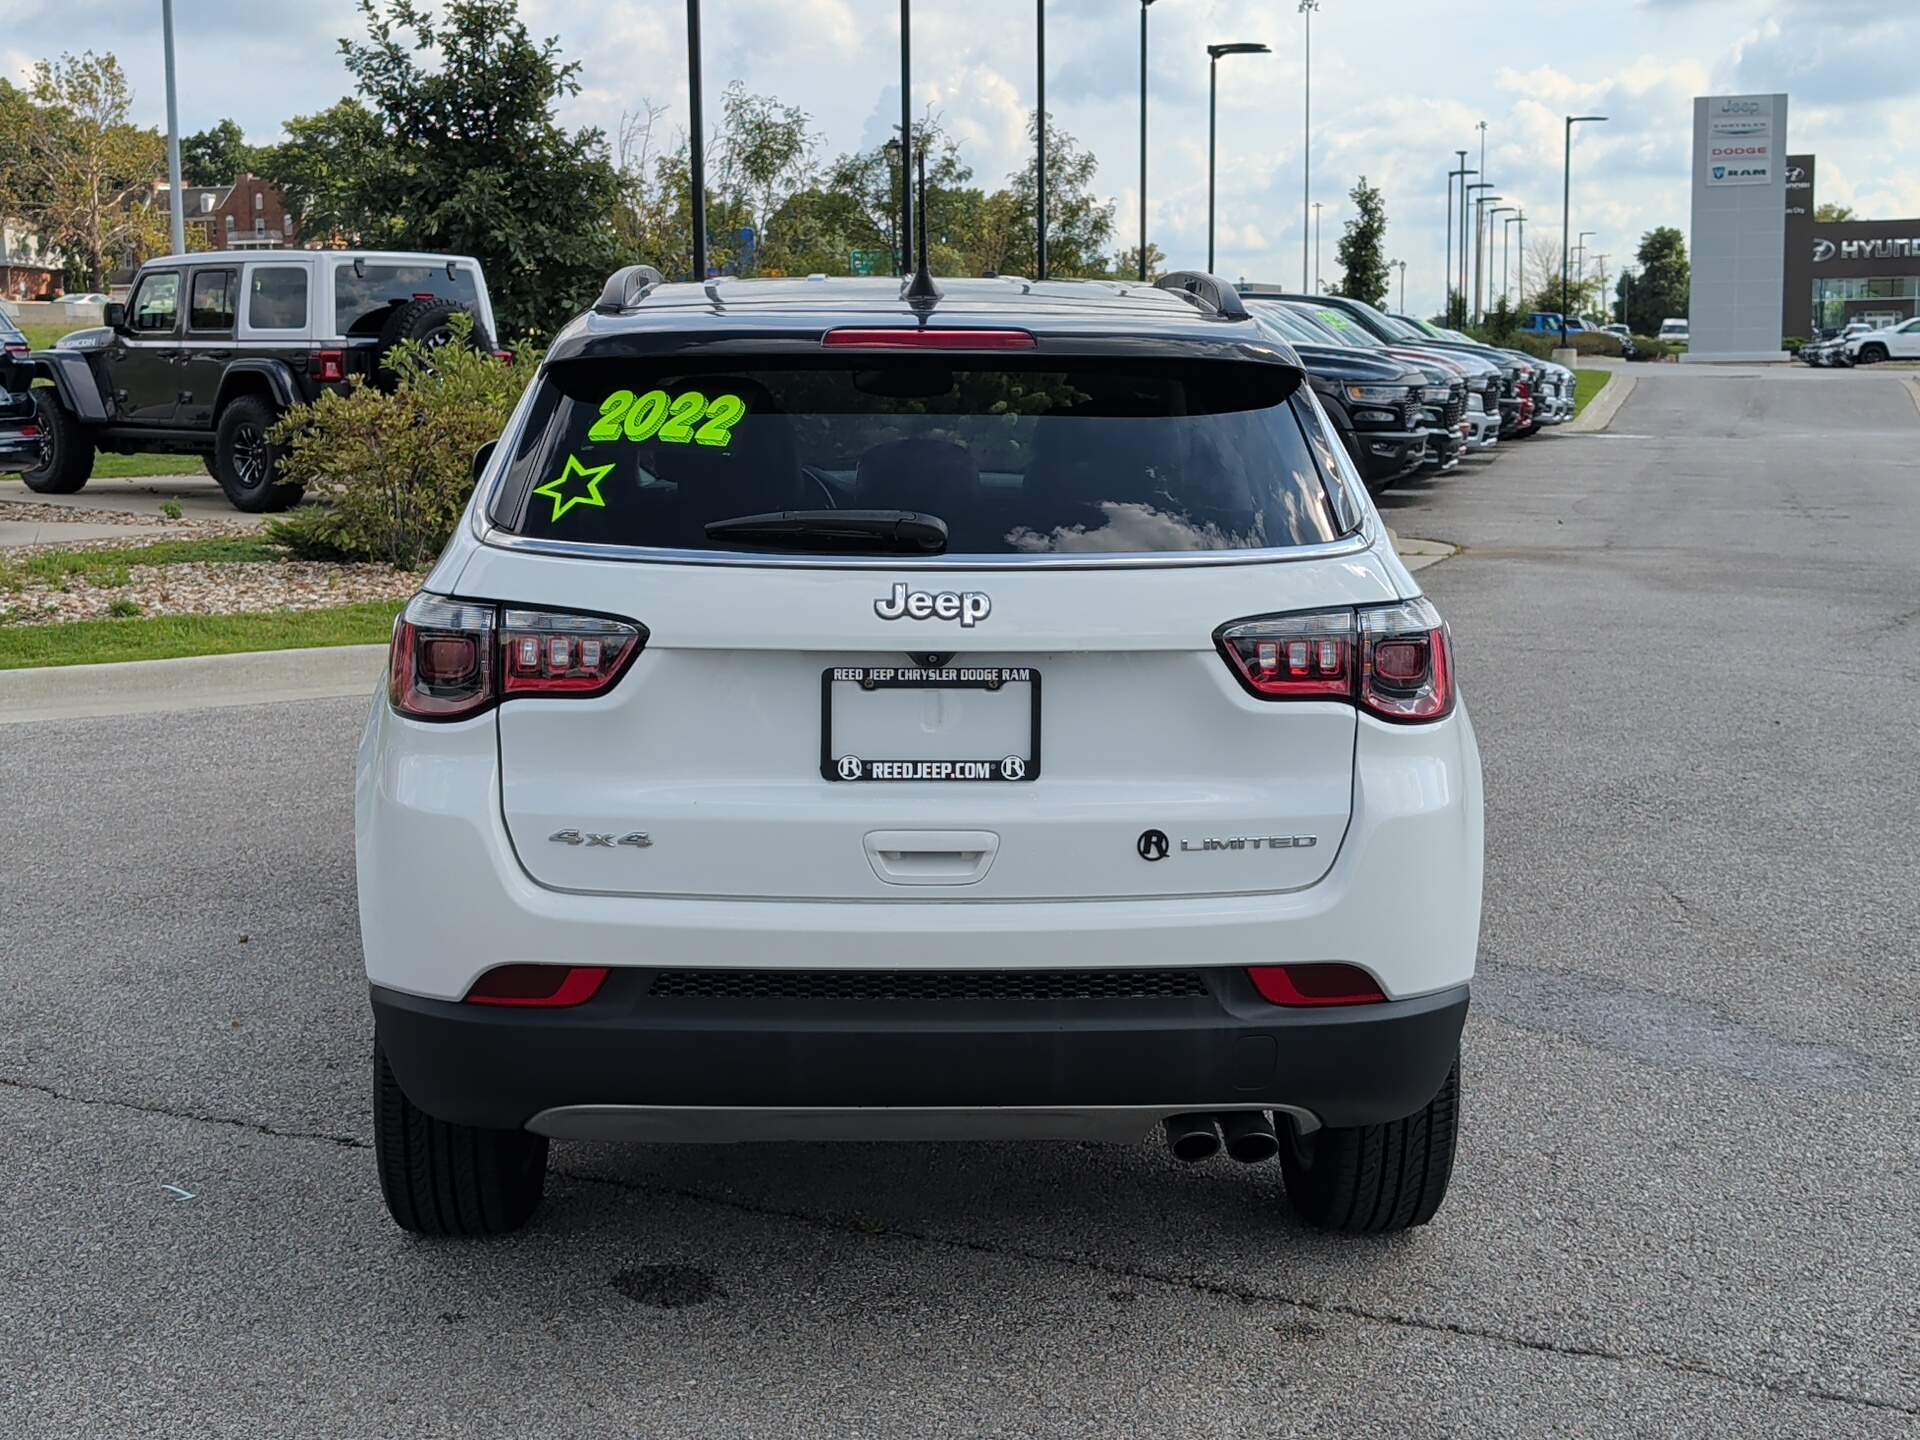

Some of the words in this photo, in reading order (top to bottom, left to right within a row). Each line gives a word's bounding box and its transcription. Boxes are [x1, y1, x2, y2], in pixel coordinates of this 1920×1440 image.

[1721, 100, 1759, 114] Jeep
[1712, 147, 1767, 155] DODGE
[56, 338, 96, 349] RUBICON
[588, 390, 746, 446] 2022
[874, 583, 992, 627] Jeep
[833, 668, 863, 680] REED
[869, 668, 894, 680] JEEP
[898, 668, 957, 680] CHRYSLER
[960, 668, 998, 680] DODGE
[1002, 668, 1030, 680] RAM
[872, 762, 990, 779] REEDJEEP.COM
[1181, 834, 1317, 851] LIMITED
